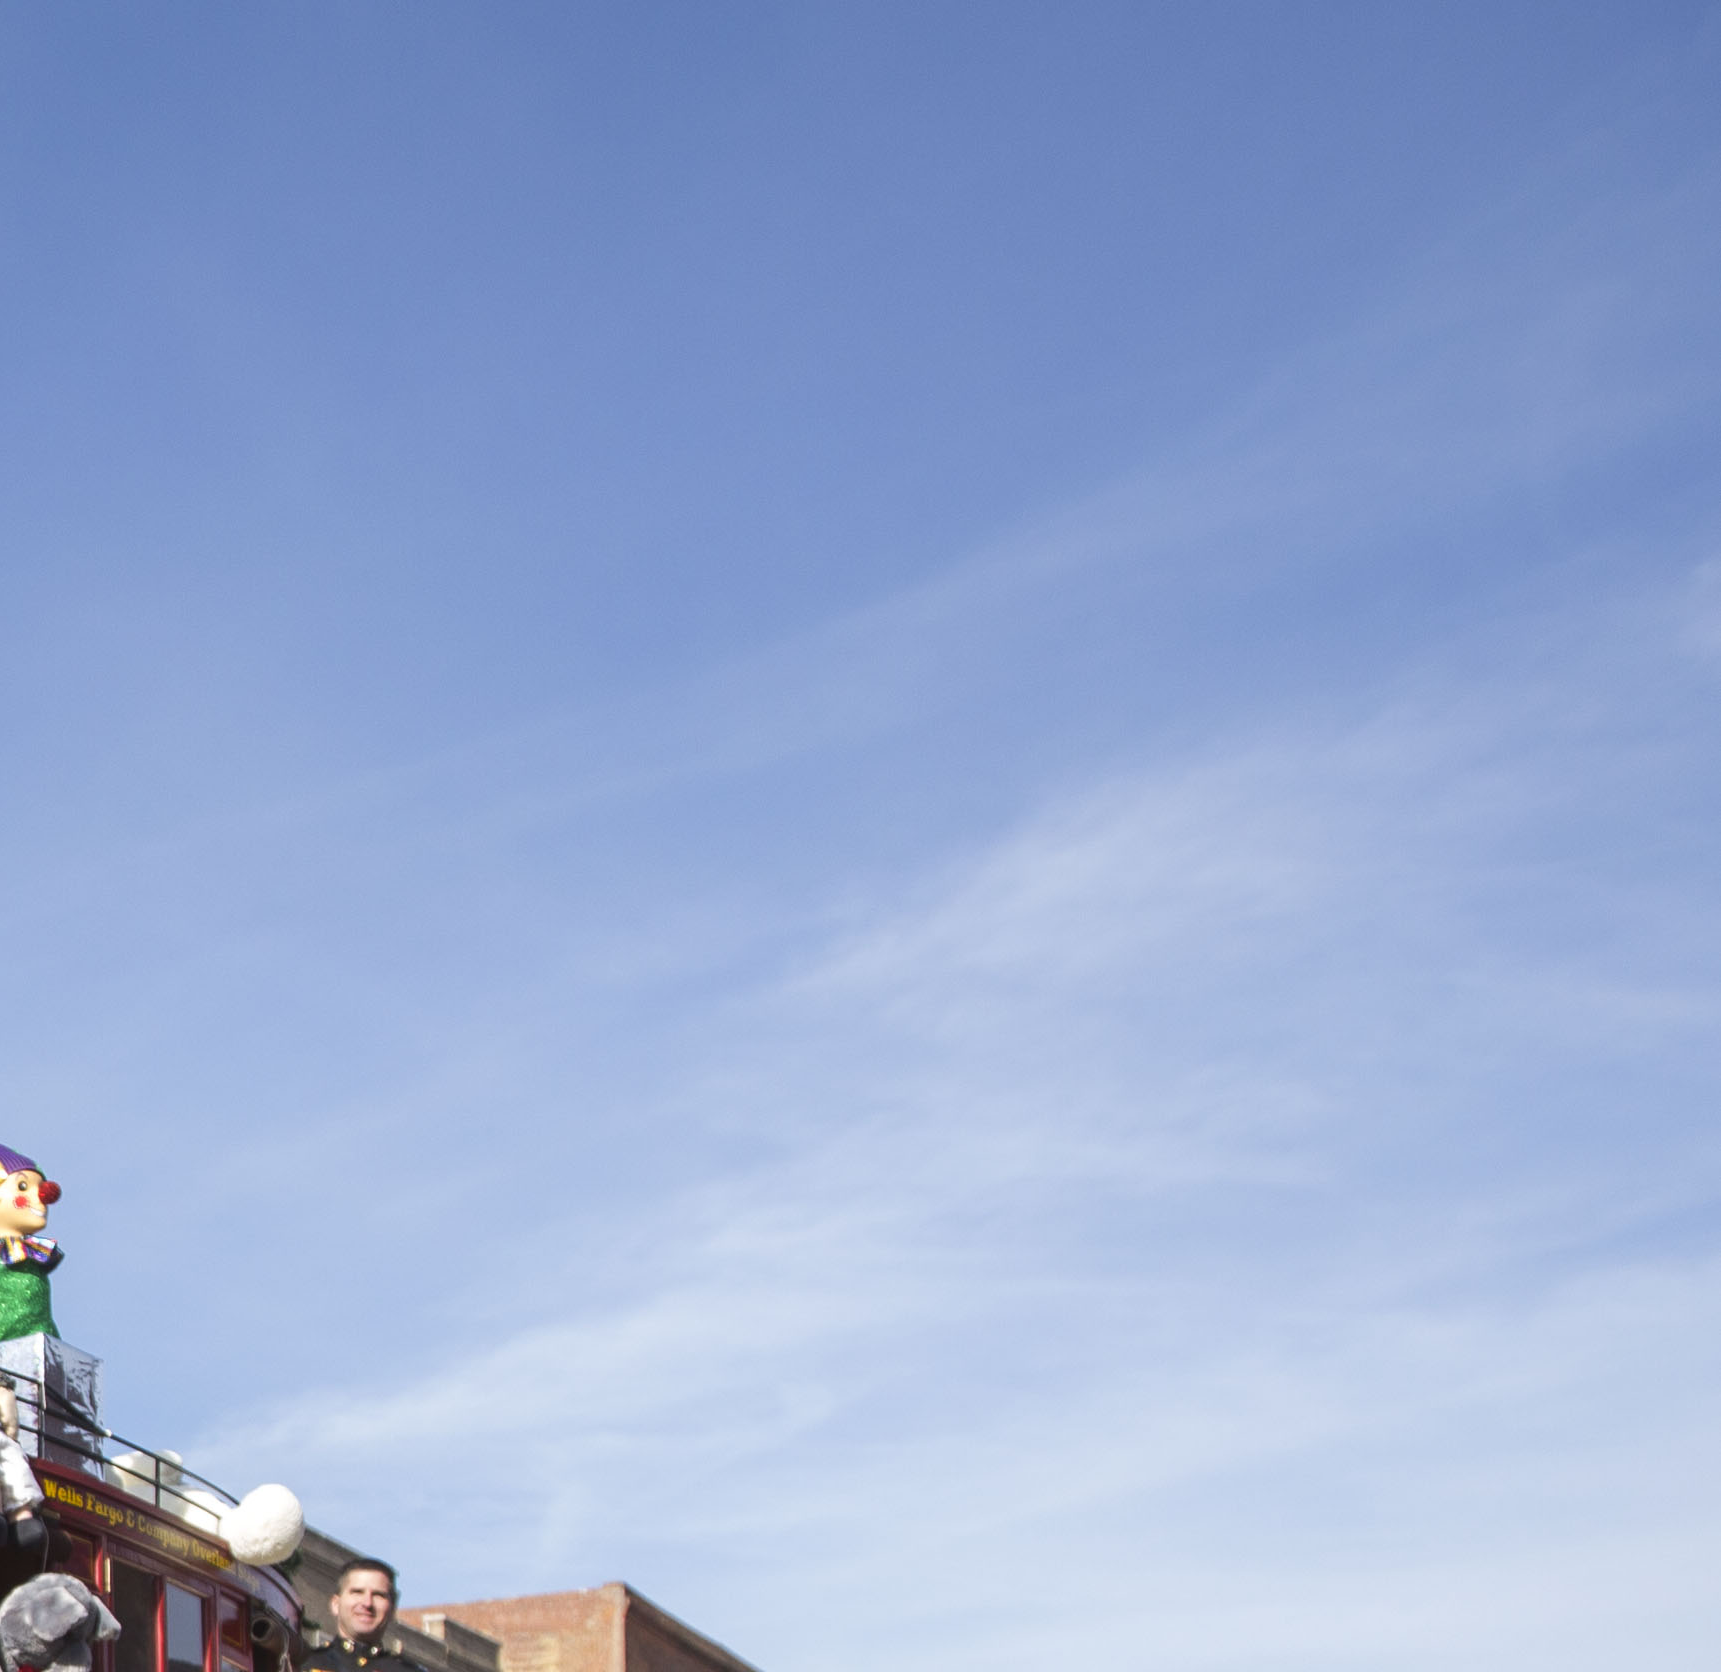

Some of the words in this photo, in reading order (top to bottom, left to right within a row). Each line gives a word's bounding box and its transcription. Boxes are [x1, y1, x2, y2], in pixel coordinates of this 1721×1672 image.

[44, 1478, 84, 1508] Wells
[85, 1491, 124, 1527] Fargo
[138, 1514, 190, 1557] Company
